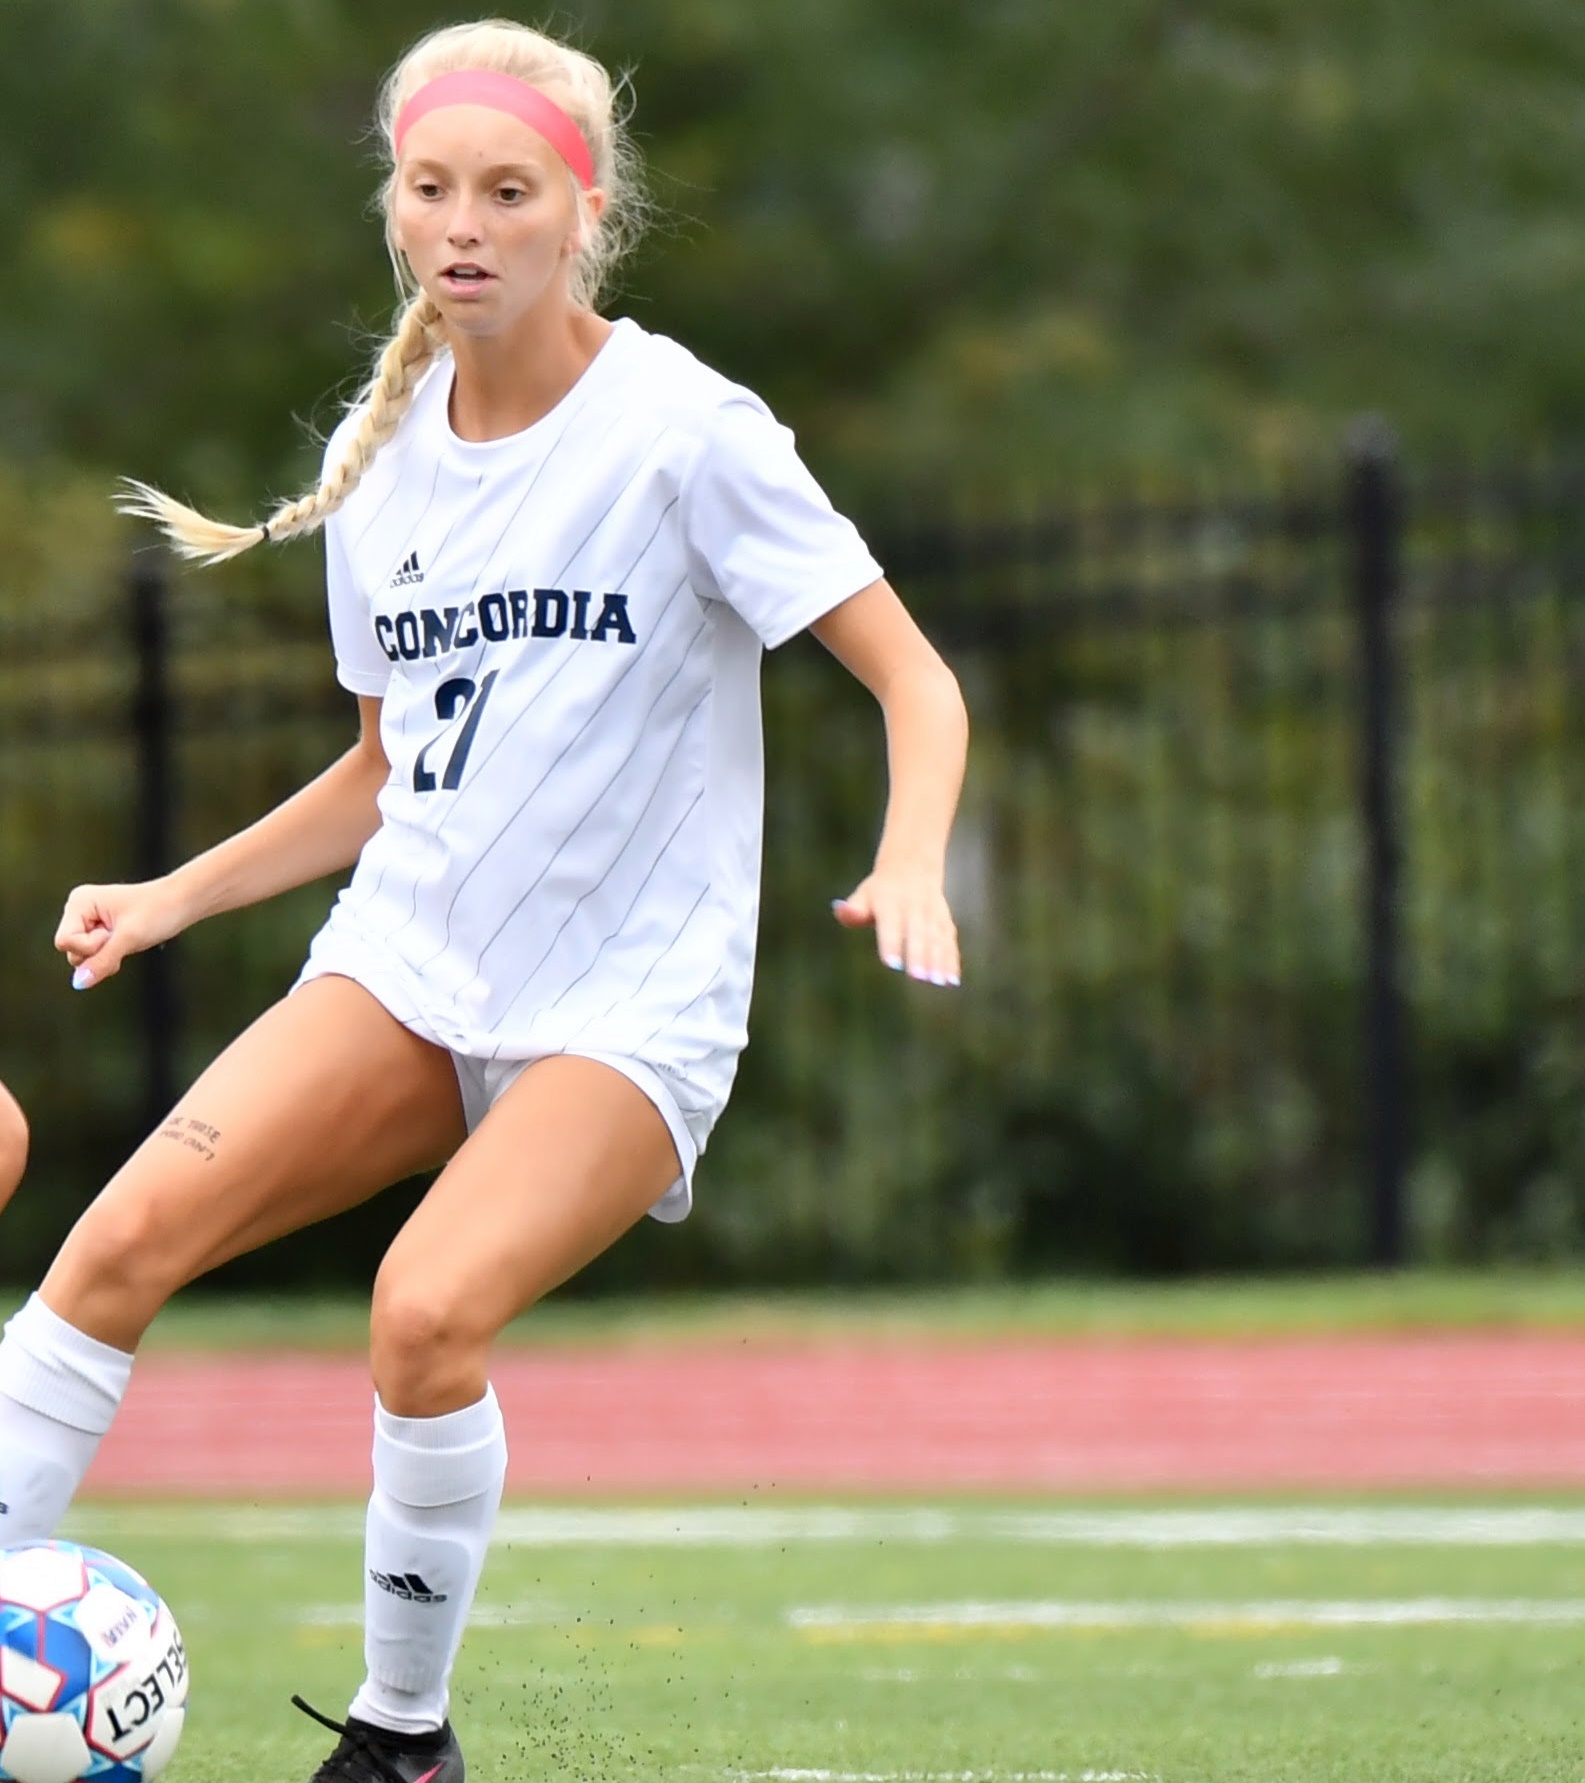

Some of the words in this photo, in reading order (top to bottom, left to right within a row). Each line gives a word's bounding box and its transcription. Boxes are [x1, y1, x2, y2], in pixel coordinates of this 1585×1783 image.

[374, 588, 637, 662] CONCORDIA
[412, 667, 501, 794] 21
[106, 1628, 186, 1744] SELECT
